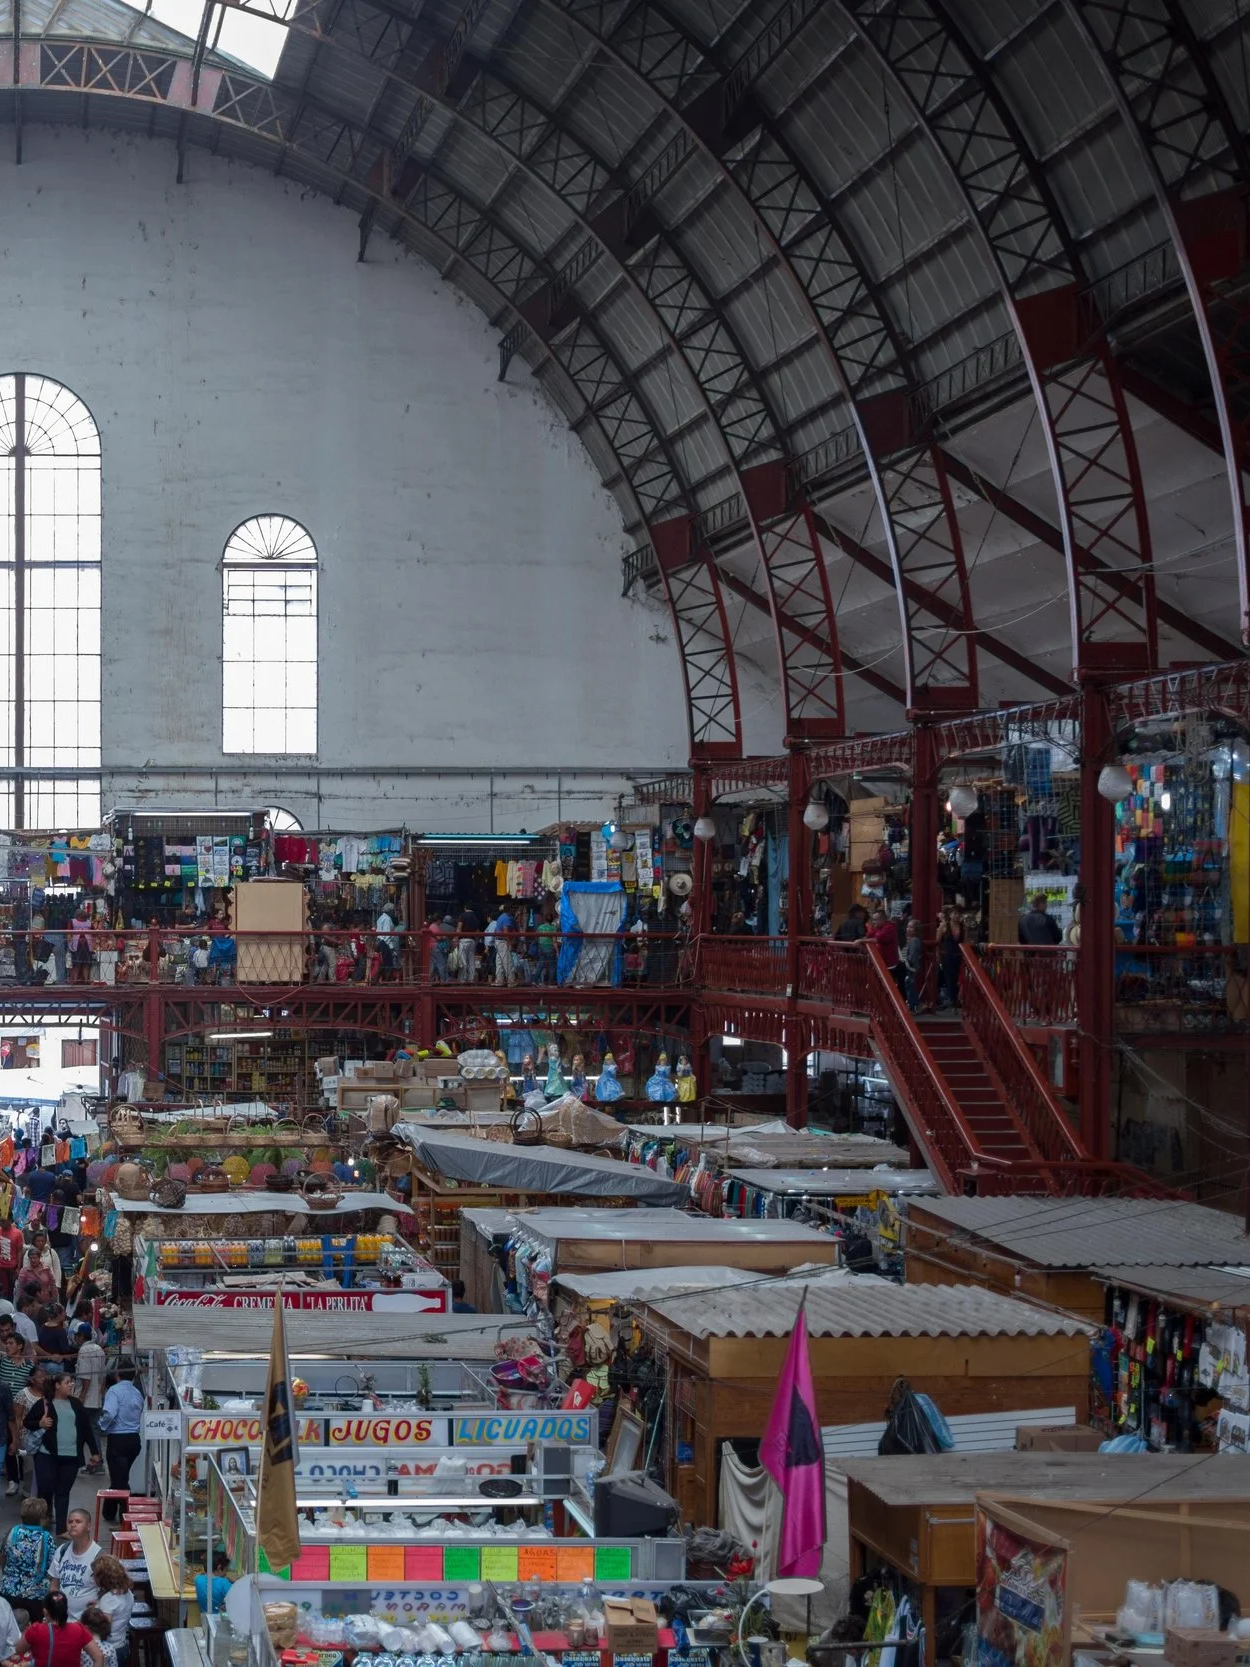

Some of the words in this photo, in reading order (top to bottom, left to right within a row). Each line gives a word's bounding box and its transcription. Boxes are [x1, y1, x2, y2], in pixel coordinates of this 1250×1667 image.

[164, 1293, 228, 1308] Coca-Cola
[307, 1296, 323, 1311] "LA
[326, 1296, 368, 1311] PERLITA"
[331, 1419, 432, 1444] JUGOS
[458, 1418, 588, 1443] LICUADOS
[524, 1549, 555, 1557] AGUAS
